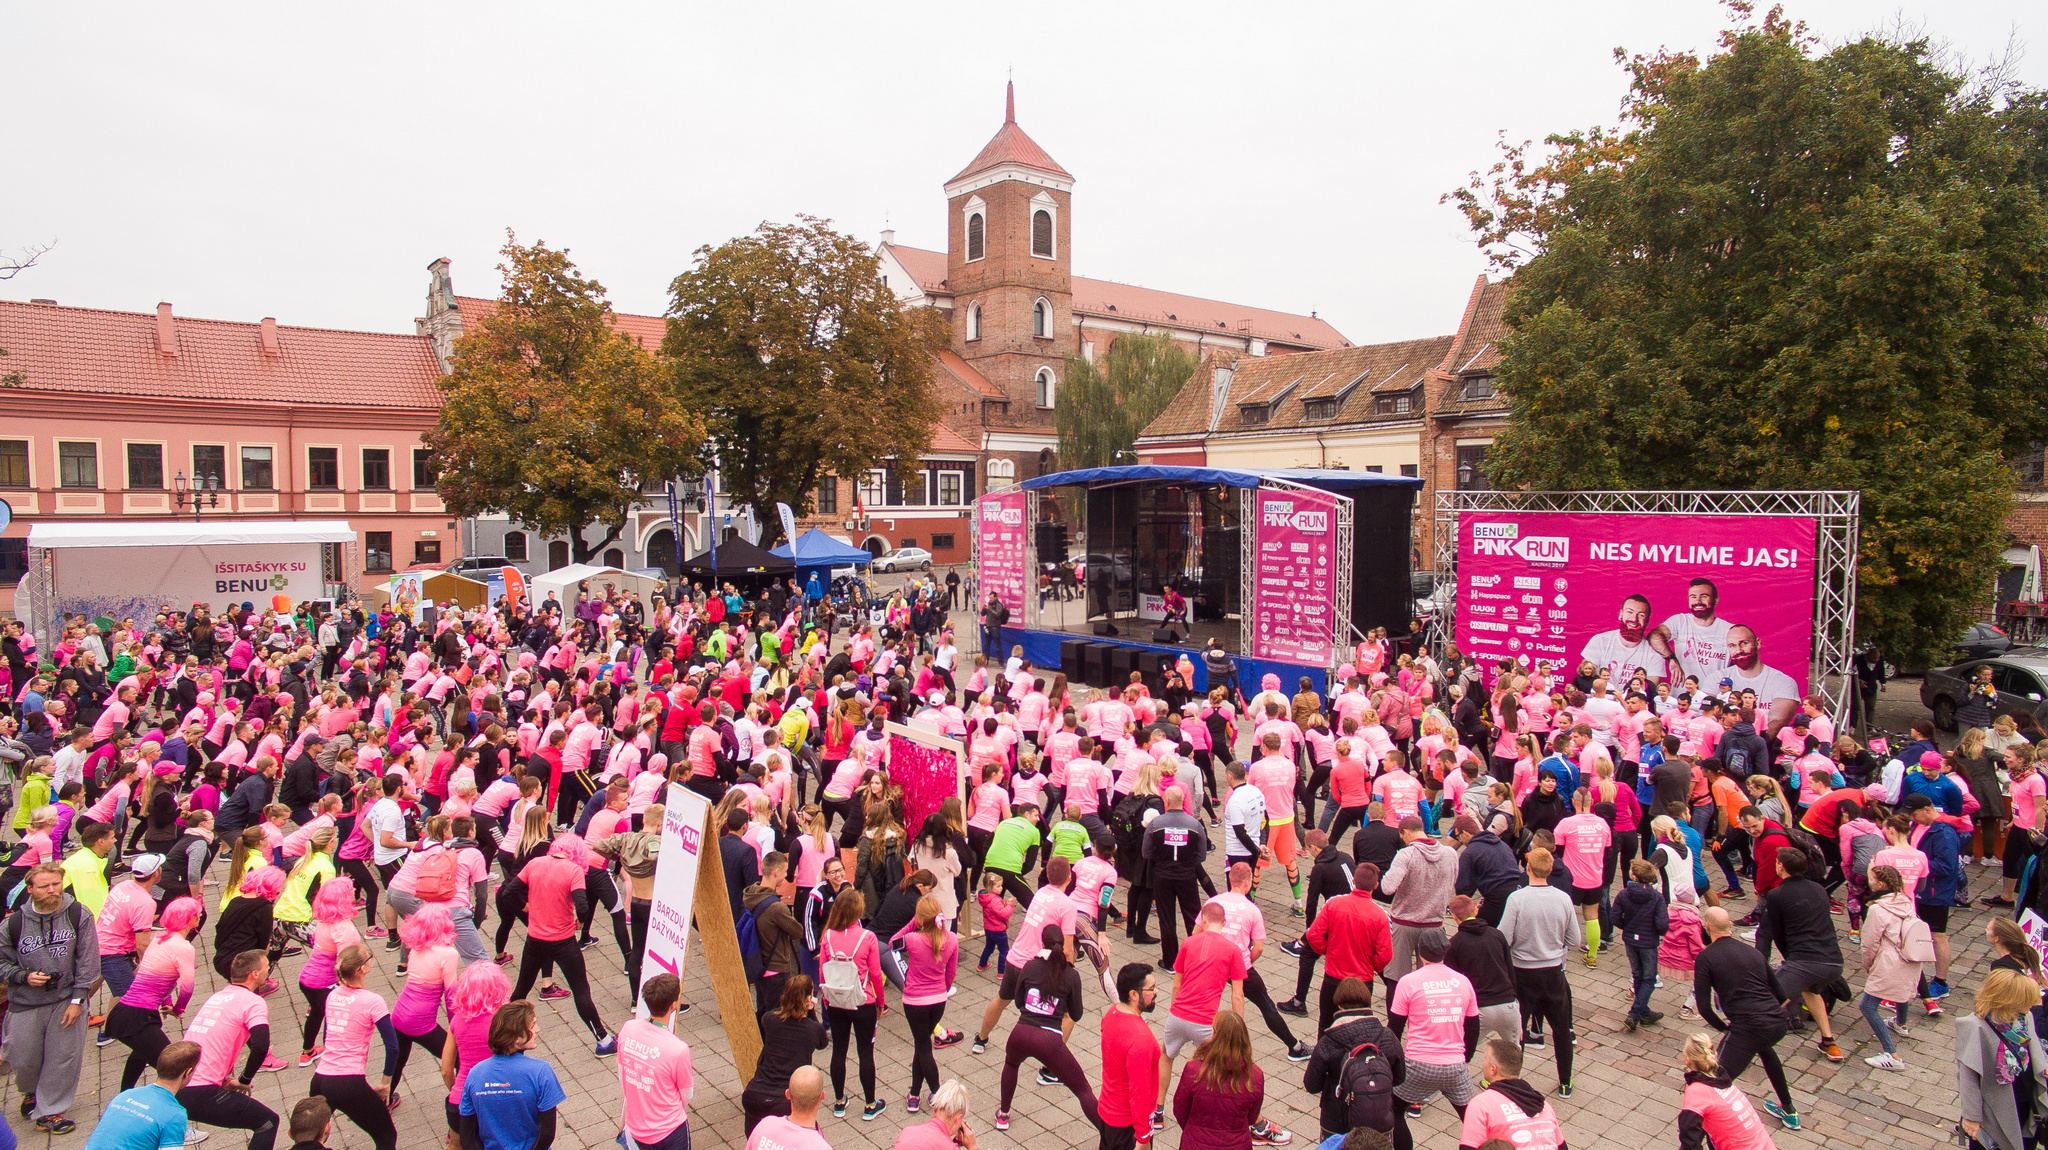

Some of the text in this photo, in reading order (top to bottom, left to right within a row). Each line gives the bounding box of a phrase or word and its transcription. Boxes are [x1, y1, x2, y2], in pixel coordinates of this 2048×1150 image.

[1264, 504, 1285, 512] BENU
[983, 511, 1001, 522] PINK
[1263, 513, 1325, 528] PINK RUN
[1475, 526, 1505, 537] BENU
[1473, 538, 1565, 558] PINK RUN
[1590, 541, 1798, 569] NES MYLIME JAS!
[215, 560, 307, 574] IŠSITAŠKYK SU
[215, 578, 268, 593] BENU
[1471, 575, 1493, 584] BENU
[1305, 594, 1326, 602] Purified
[1146, 602, 1163, 612] PINK
[1469, 620, 1509, 632] COSMOPOLITAN
[1536, 643, 1566, 653] Purified
[1698, 641, 1713, 650] NES
[1697, 649, 1727, 661] MYLIME
[665, 818, 699, 847] PINK RUN
[1169, 834, 1184, 842] 208
[656, 900, 685, 931] BARZDŲ
[651, 916, 685, 950] DAŽYMAS
[49, 945, 68, 958] 72
[1422, 980, 1451, 990] BENU
[1031, 997, 1049, 1010] 526
[624, 1037, 651, 1055] BENU
